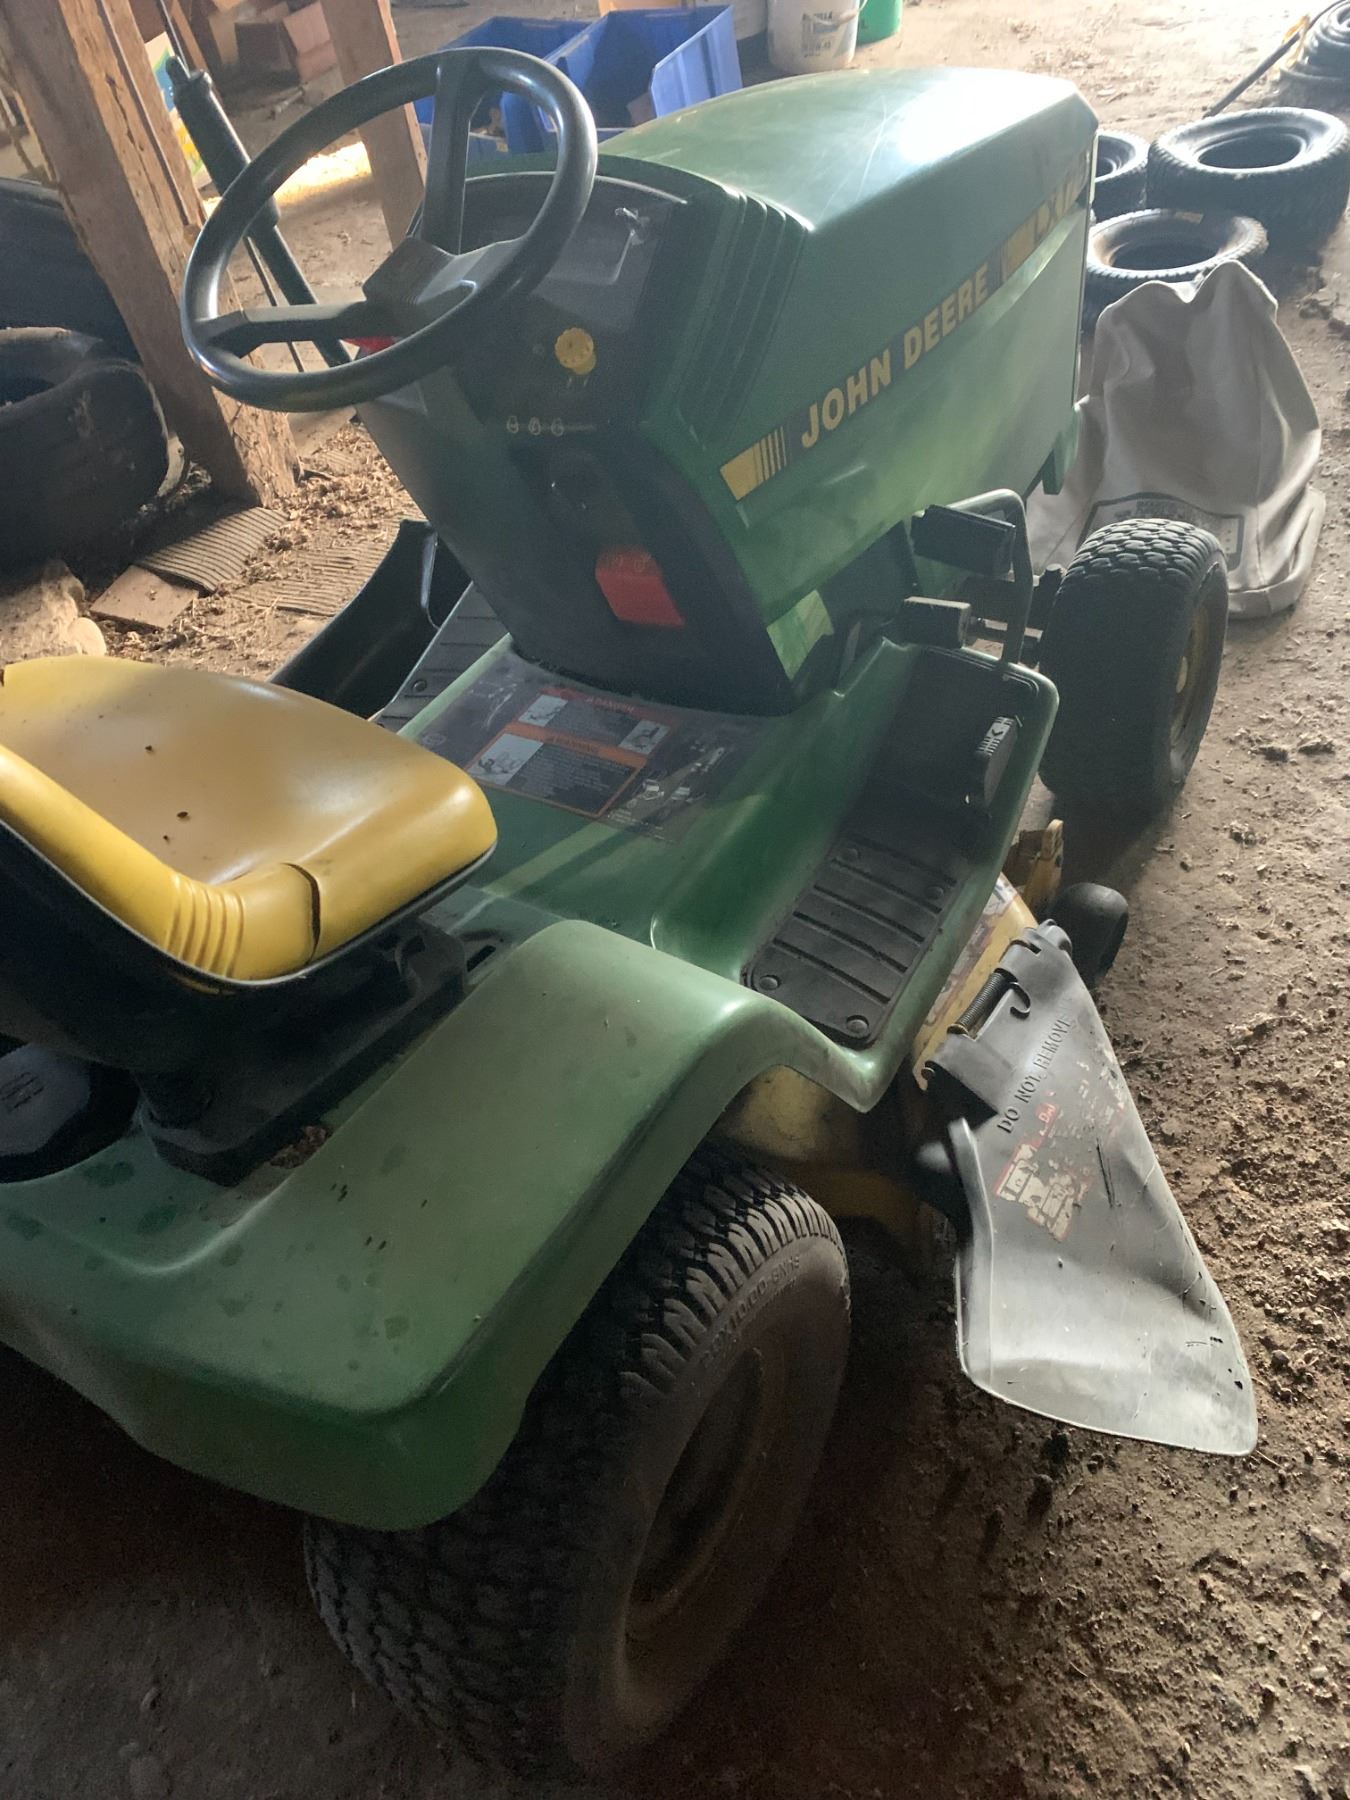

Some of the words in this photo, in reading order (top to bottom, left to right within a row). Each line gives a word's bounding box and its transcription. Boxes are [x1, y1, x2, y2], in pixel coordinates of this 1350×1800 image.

[801, 349, 892, 448] JOHN
[904, 262, 989, 370] DEERE
[996, 1106, 1020, 1135] DO
[1014, 1075, 1042, 1104] NOT
[1033, 1018, 1073, 1071] REMOVE
